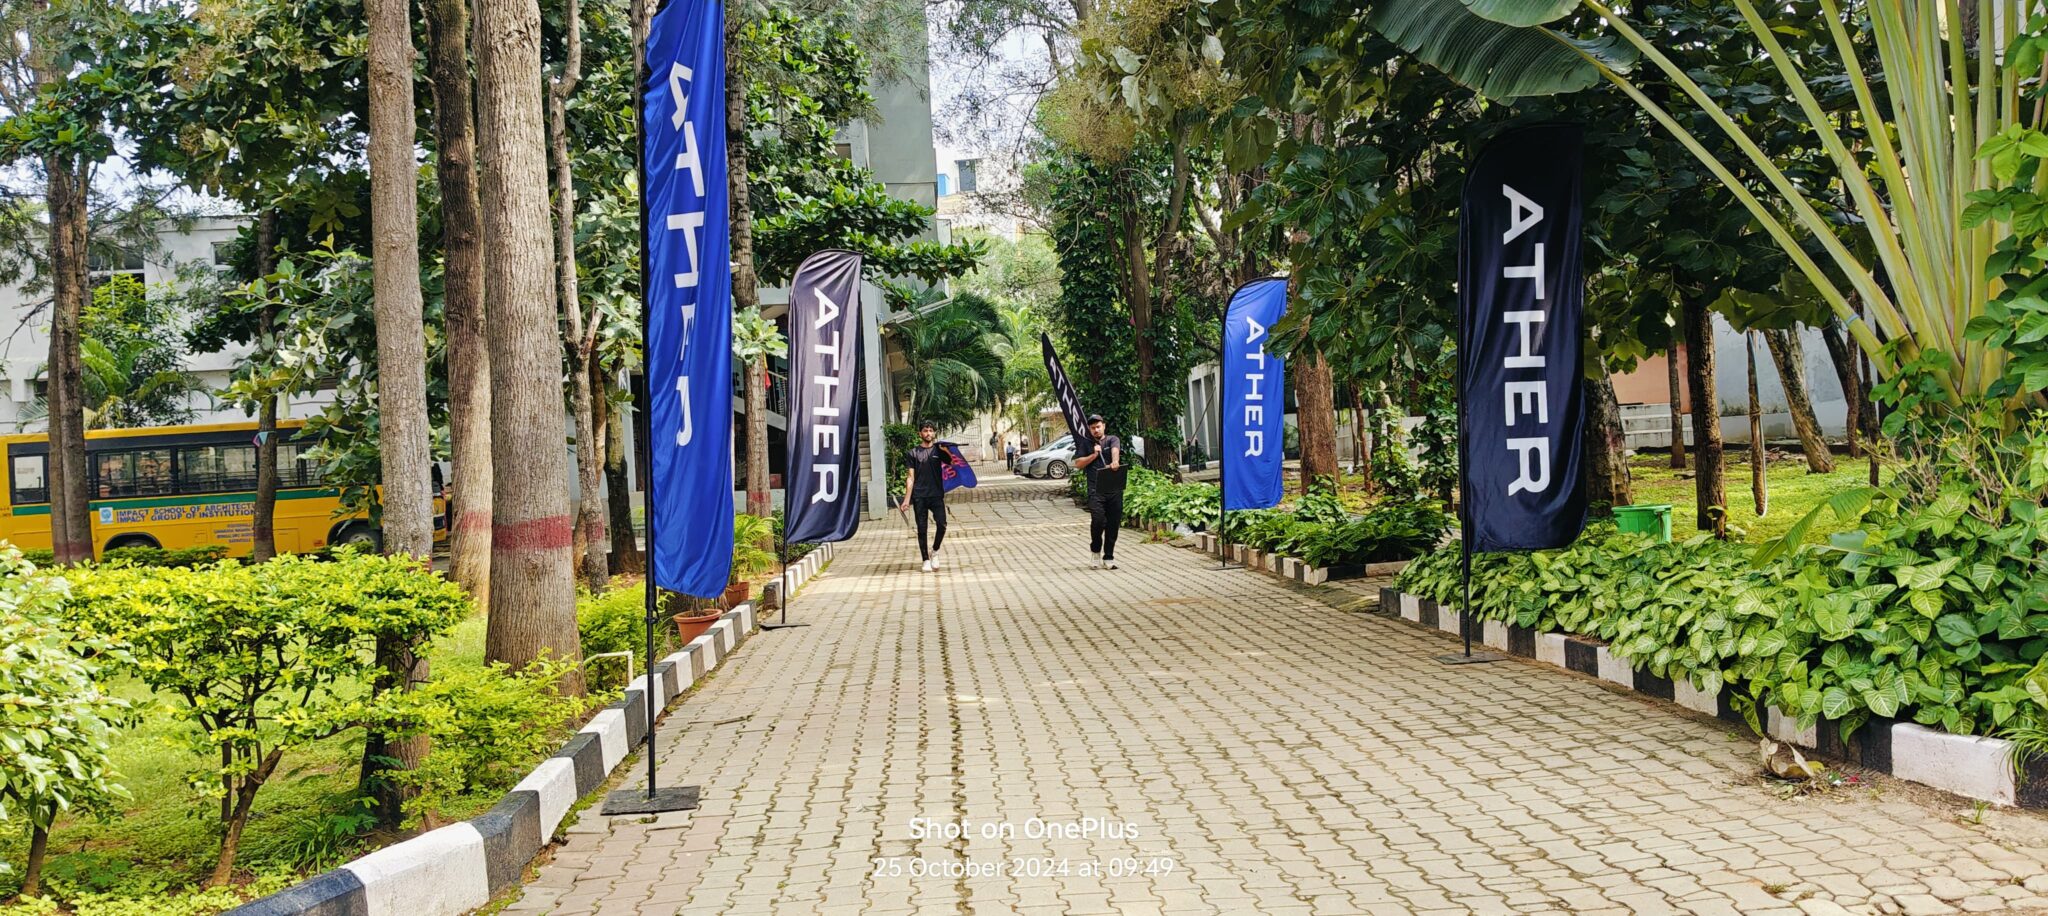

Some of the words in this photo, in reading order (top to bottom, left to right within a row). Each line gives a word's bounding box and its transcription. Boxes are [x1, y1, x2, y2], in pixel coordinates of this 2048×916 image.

[811, 287, 839, 505] ATHER
[1244, 316, 1265, 458] ATHER
[1502, 183, 1551, 497] ATHER
[116, 509, 149, 517] IMPACT
[154, 507, 186, 515] SCHOOL
[190, 505, 202, 514] OF
[151, 513, 182, 521] GROUP
